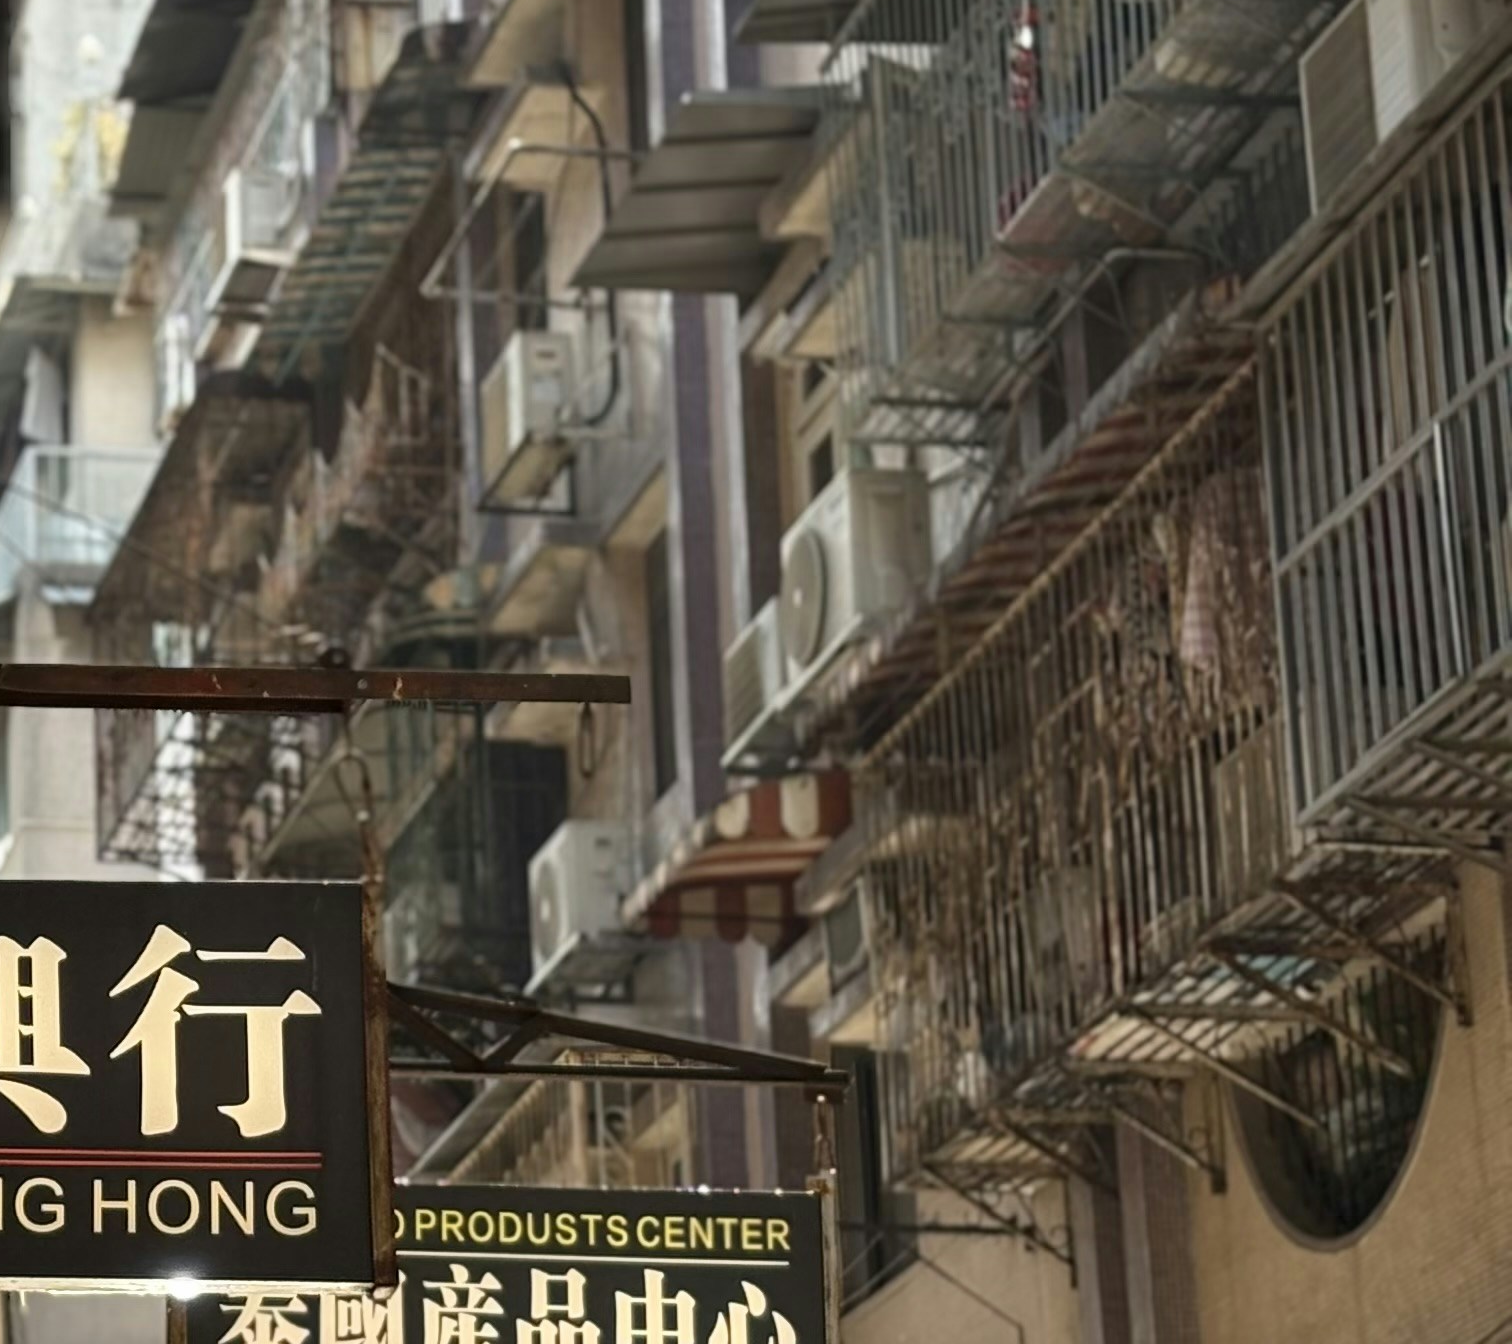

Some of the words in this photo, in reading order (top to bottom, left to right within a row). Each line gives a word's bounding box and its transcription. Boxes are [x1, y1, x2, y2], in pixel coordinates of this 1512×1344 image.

[92, 1178, 318, 1237] HONG
[414, 1208, 629, 1248] PRODUSTS
[635, 1214, 790, 1251] CENTER
